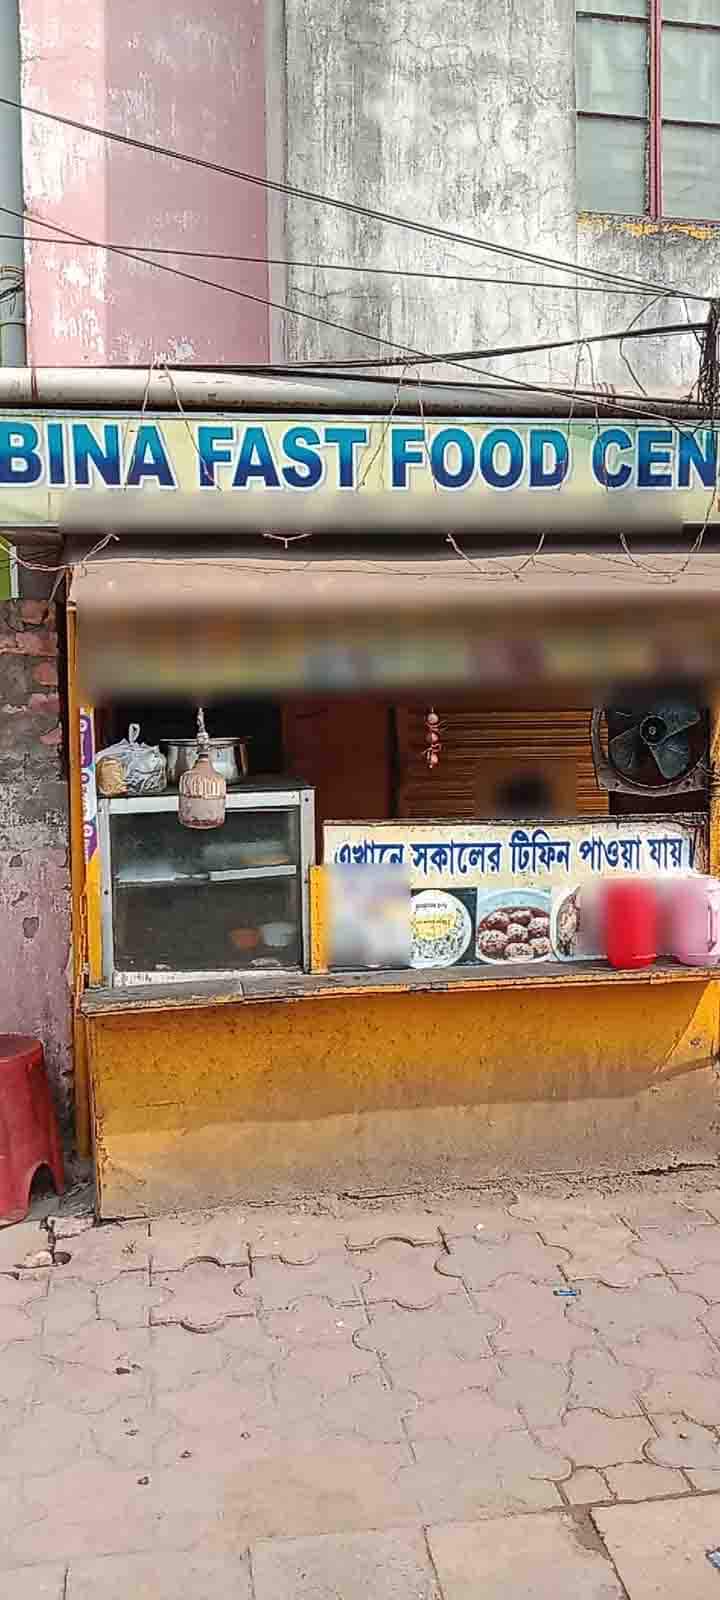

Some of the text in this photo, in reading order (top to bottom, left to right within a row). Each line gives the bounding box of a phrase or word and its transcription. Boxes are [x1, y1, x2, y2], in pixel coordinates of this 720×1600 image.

[0, 421, 717, 489] BINA FAST FOOD CEN
[410, 841, 501, 874] সকালের
[509, 830, 570, 872] টিফিন
[579, 835, 641, 870] পাওয়া
